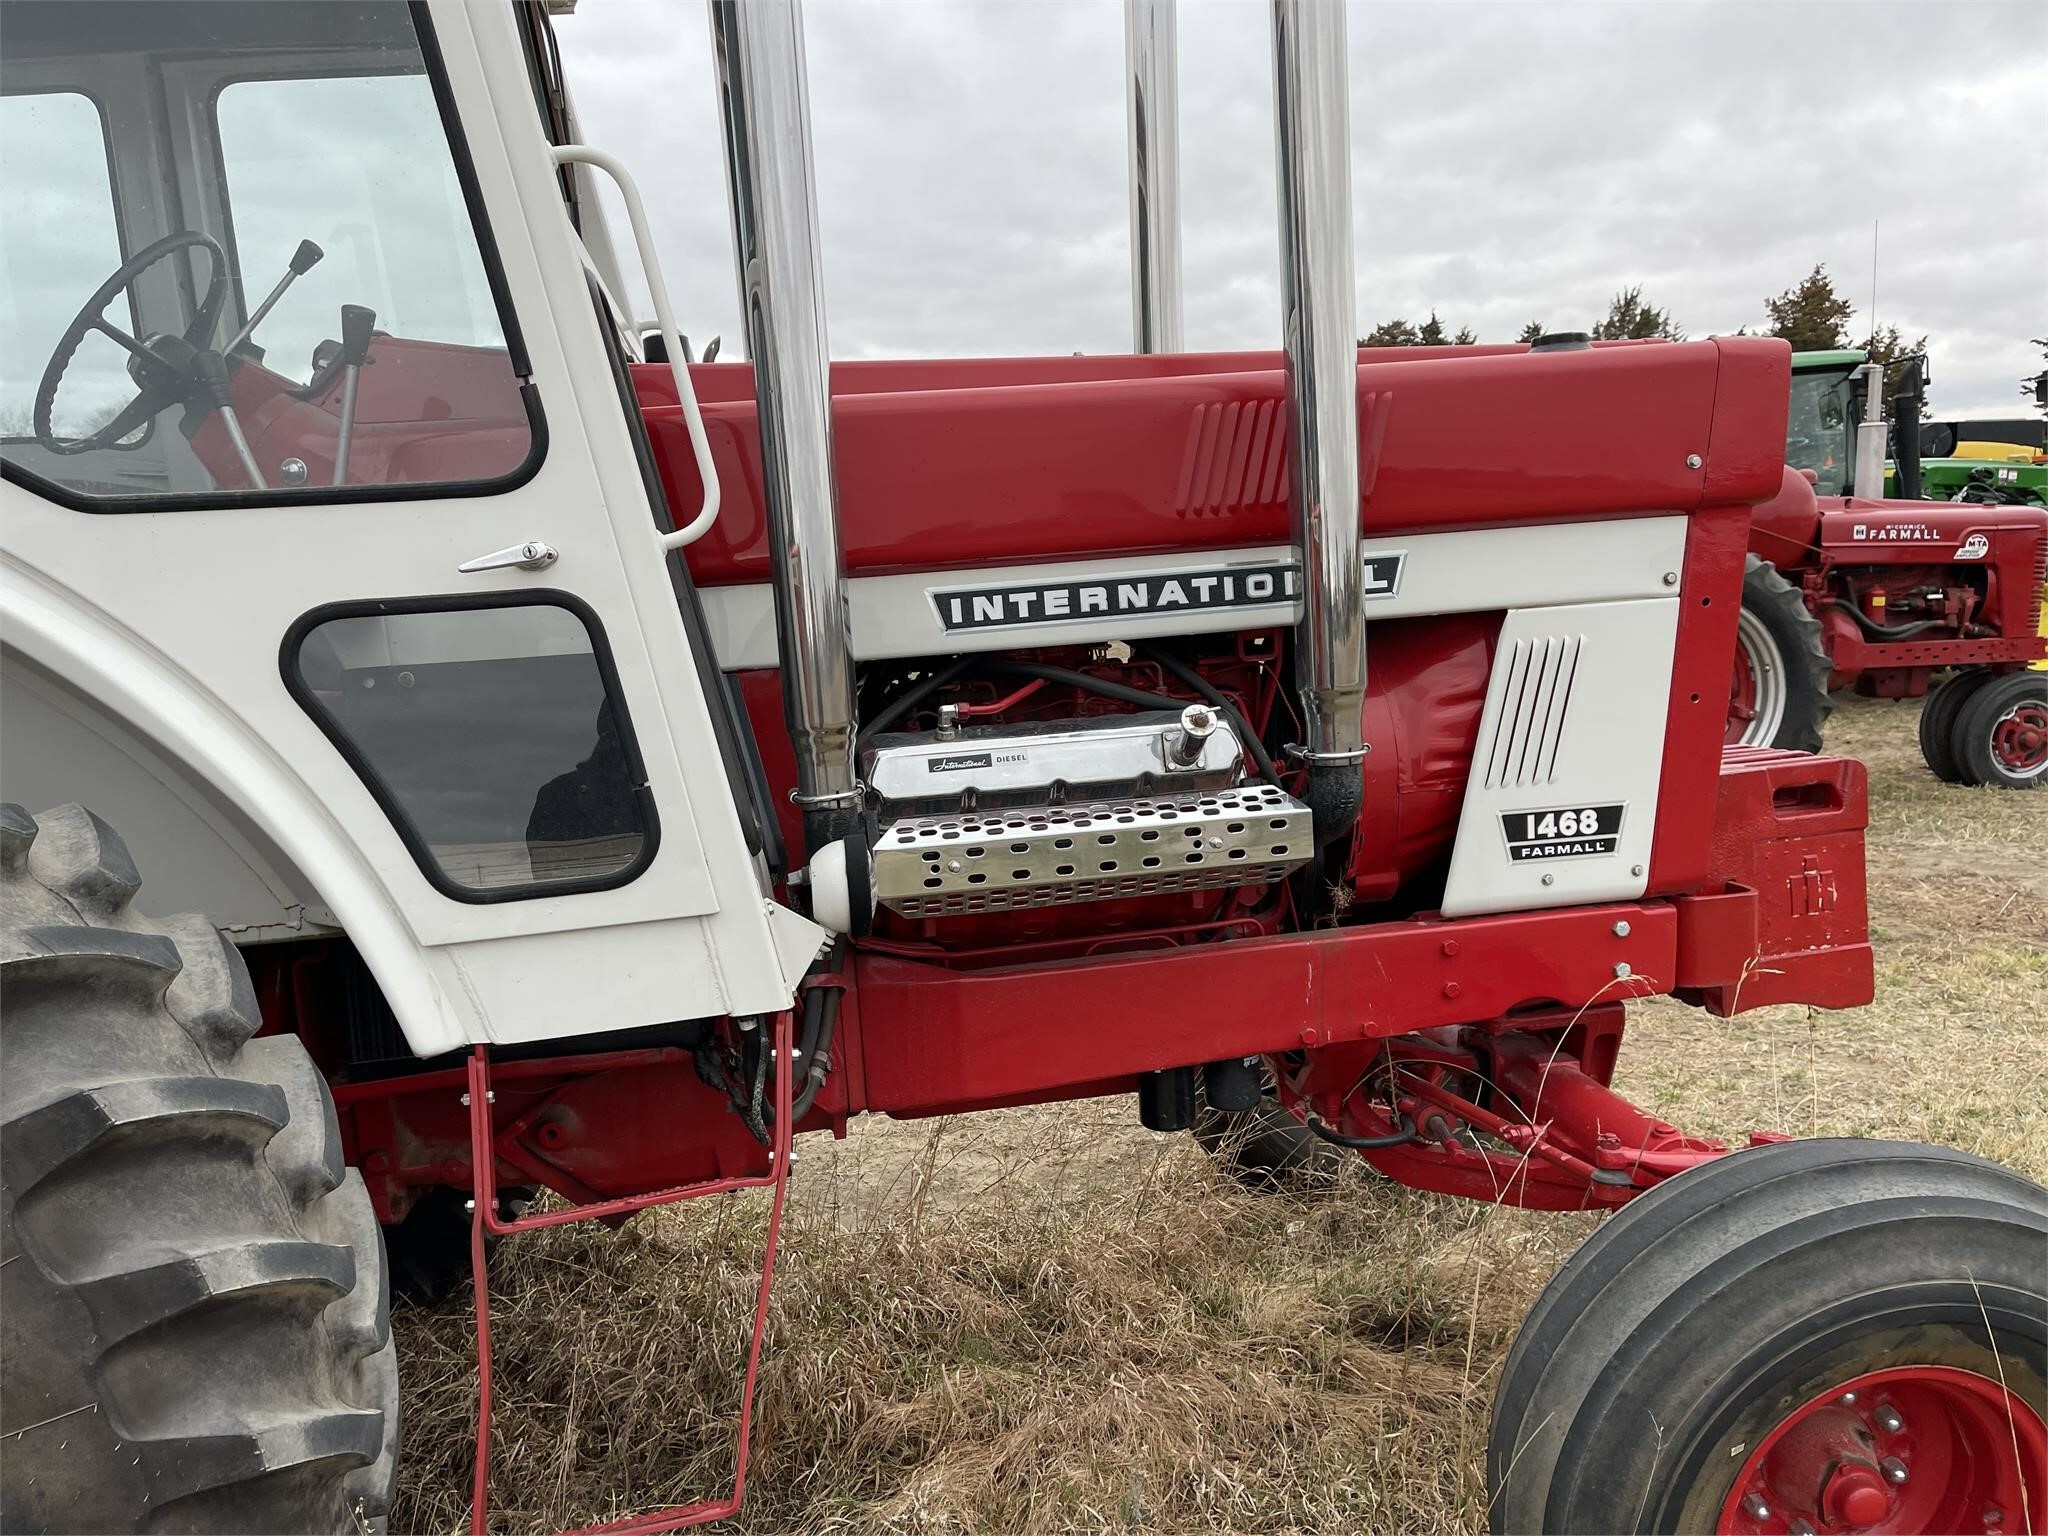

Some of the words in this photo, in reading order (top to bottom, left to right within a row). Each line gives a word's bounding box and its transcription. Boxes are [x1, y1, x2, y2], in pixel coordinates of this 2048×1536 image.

[1869, 529, 1940, 540] FARMALL
[950, 564, 1388, 624] INTERNATIOL
[933, 759, 988, 772] International
[996, 754, 1027, 763] DIESEL
[1526, 808, 1599, 840] 1468
[1521, 842, 1605, 857] FARMALL
